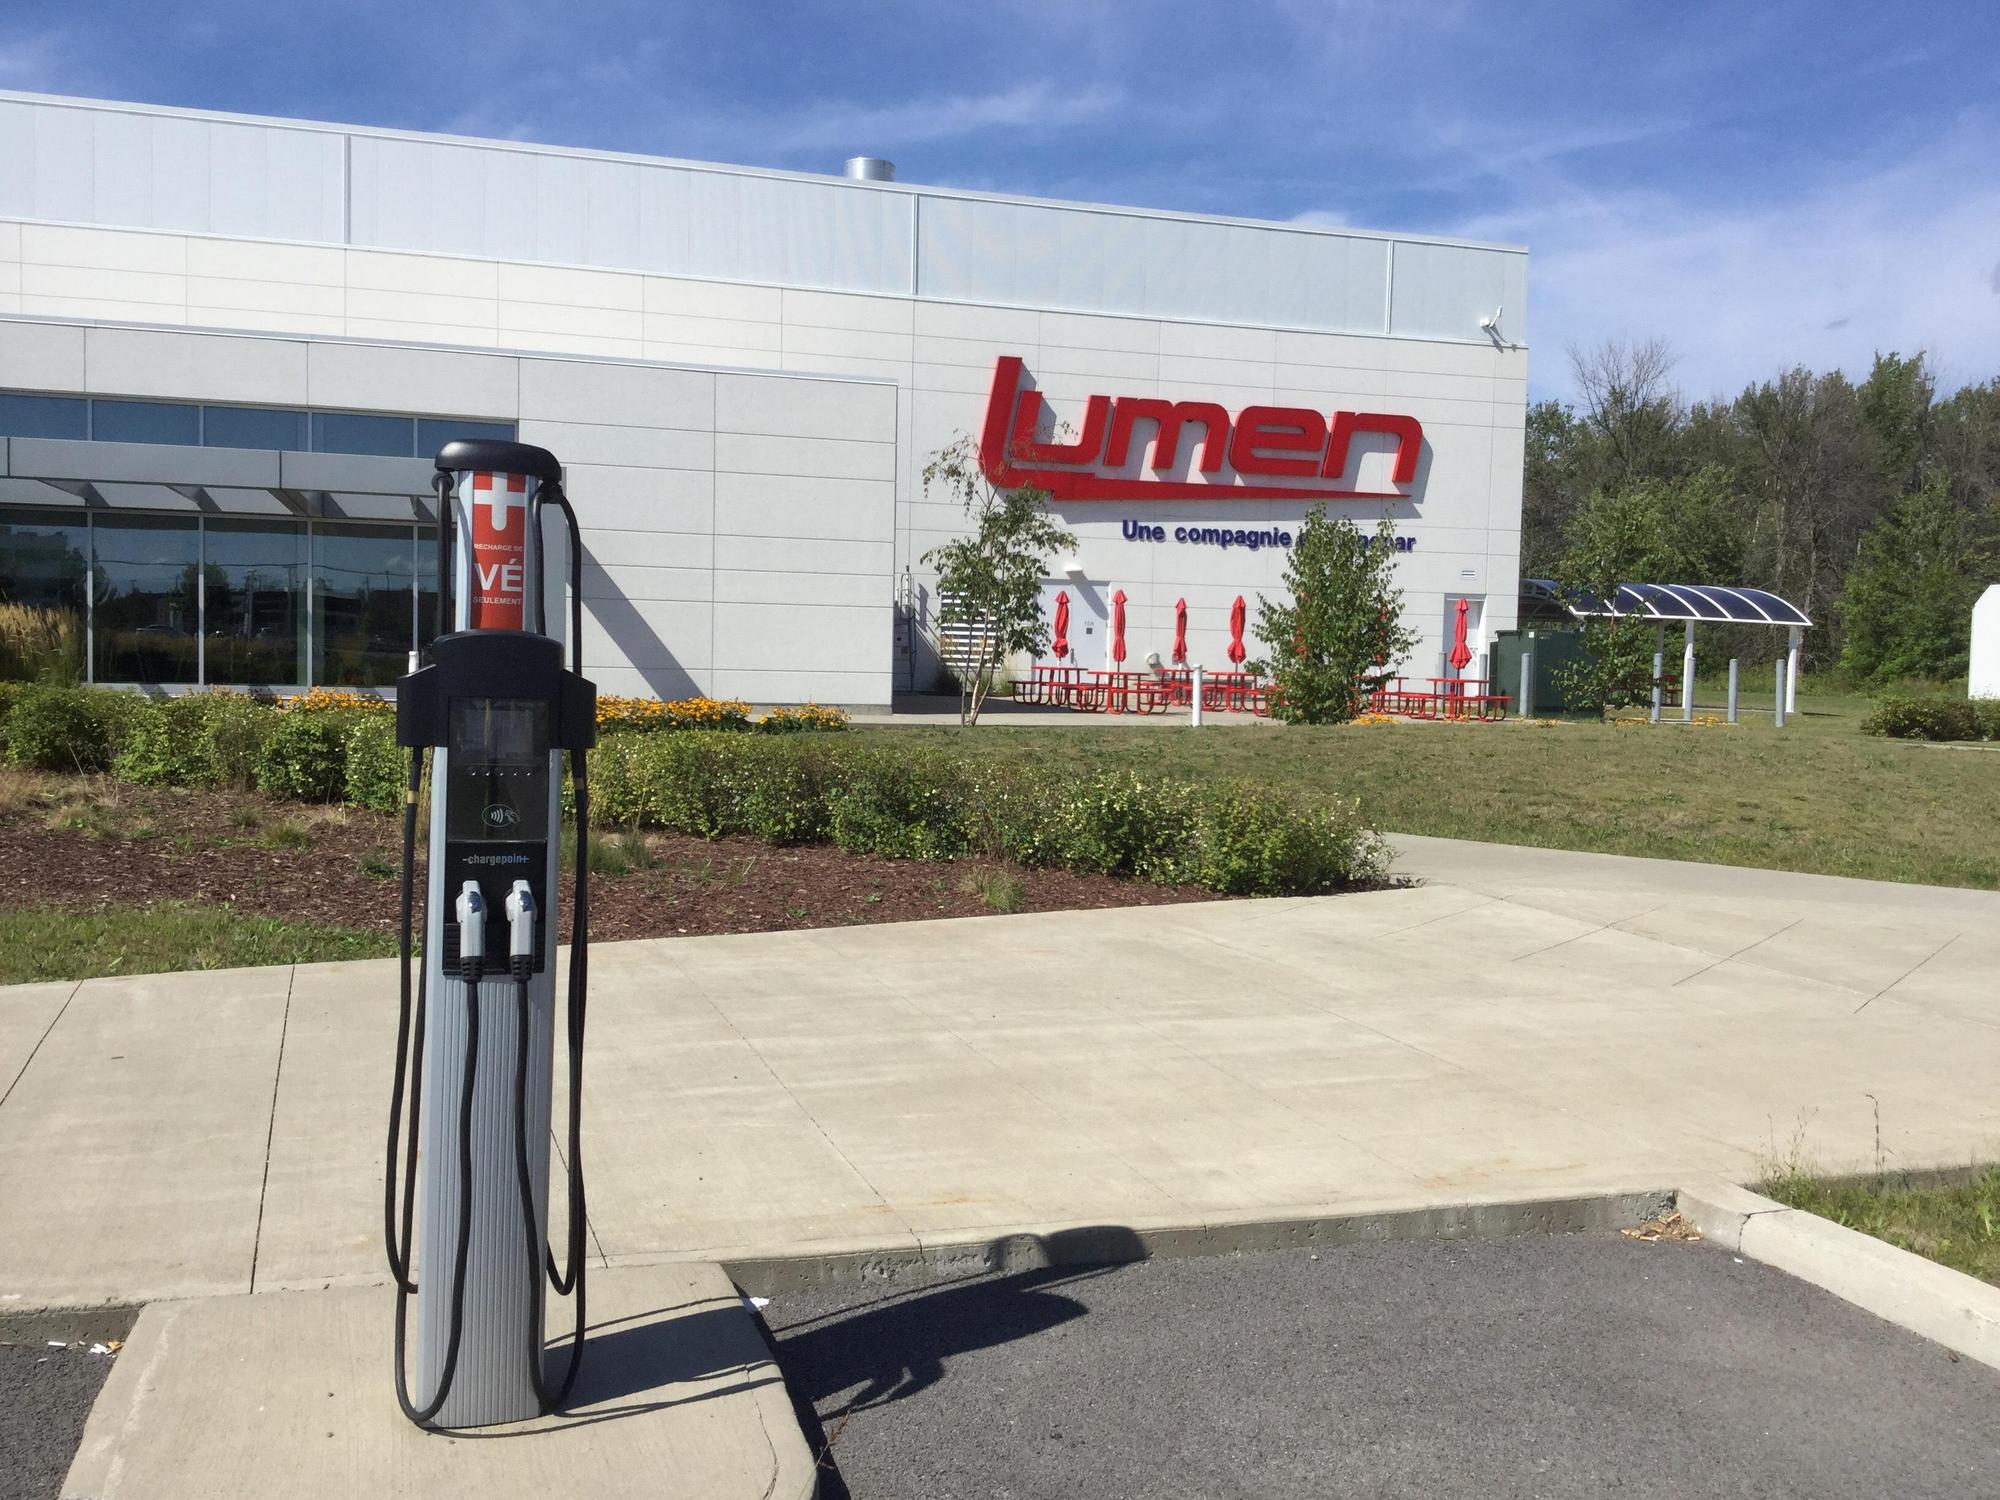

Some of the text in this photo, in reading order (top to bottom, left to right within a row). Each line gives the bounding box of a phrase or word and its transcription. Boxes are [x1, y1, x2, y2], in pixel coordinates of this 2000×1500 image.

[1122, 519, 1165, 541] Une
[1174, 524, 1292, 549] compagnie
[473, 543, 512, 551] RECHARGE
[473, 558, 522, 592] VÉ
[473, 596, 521, 605] SEULEMENT
